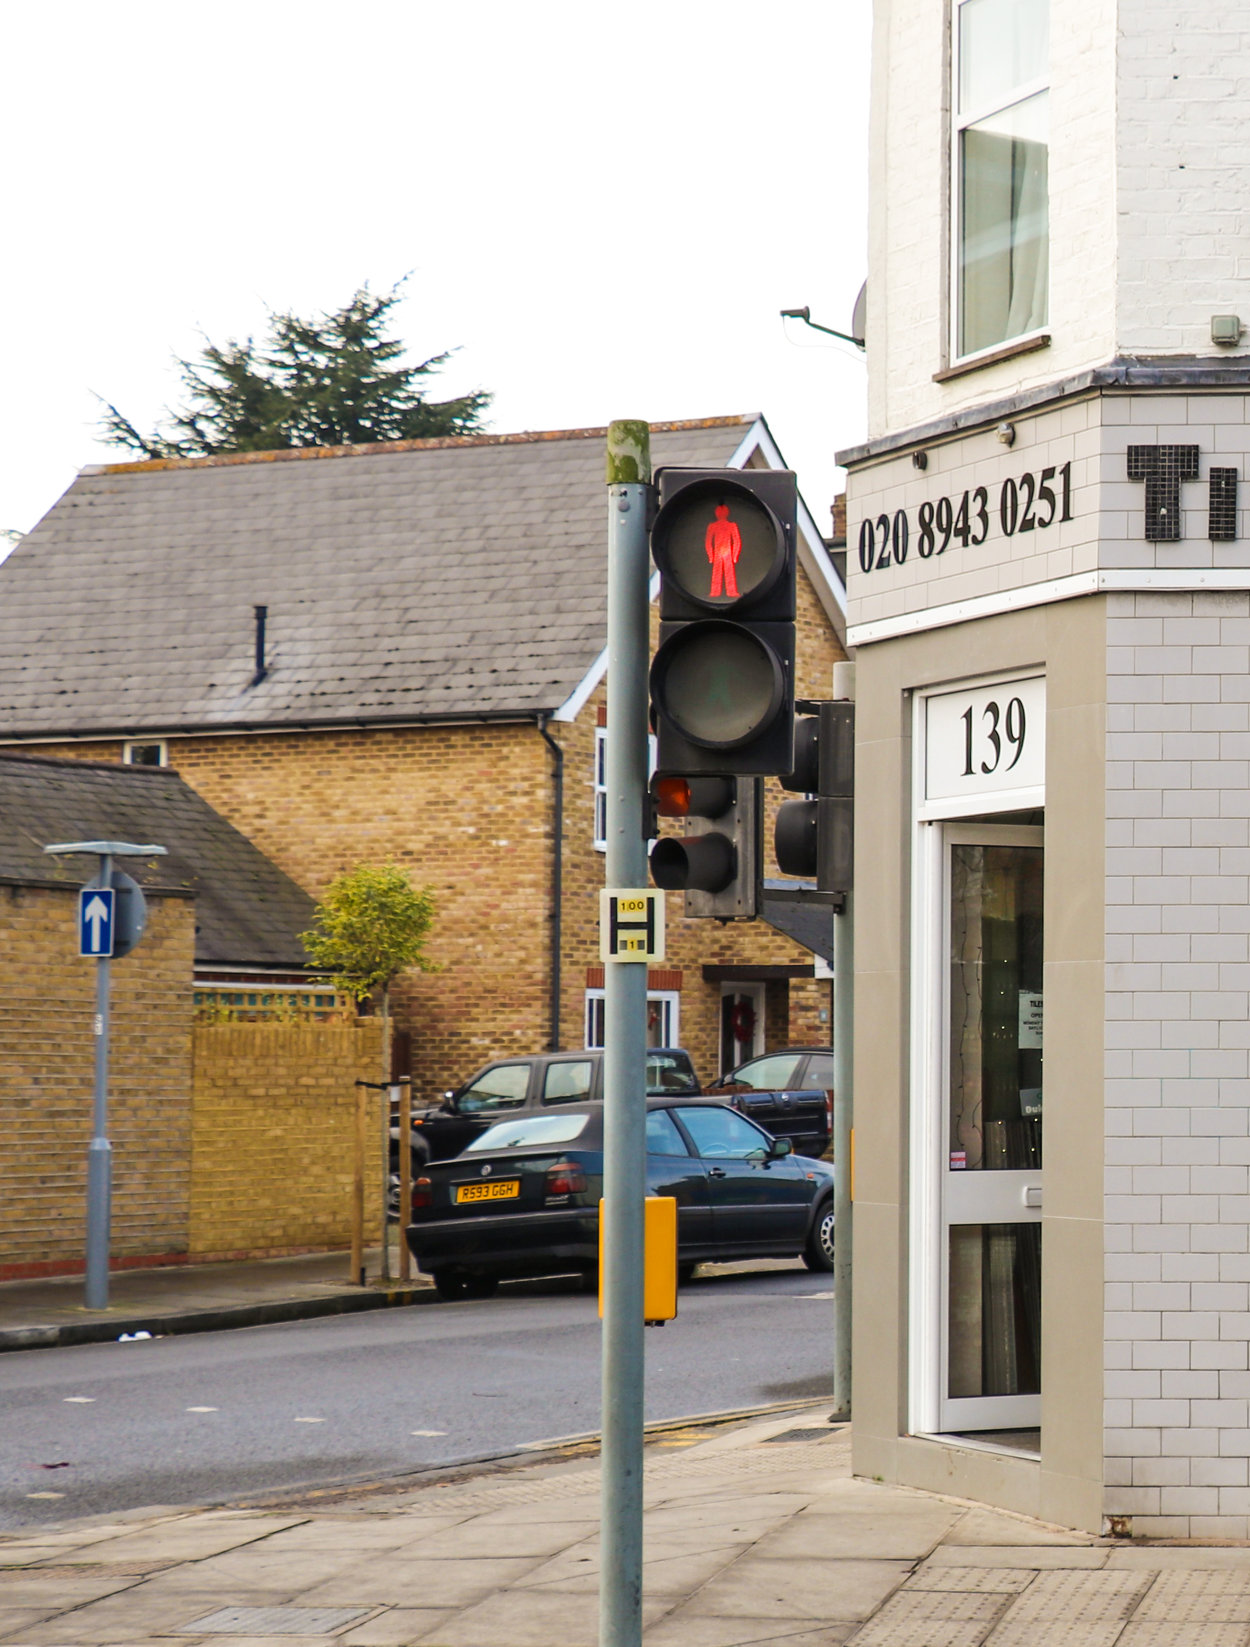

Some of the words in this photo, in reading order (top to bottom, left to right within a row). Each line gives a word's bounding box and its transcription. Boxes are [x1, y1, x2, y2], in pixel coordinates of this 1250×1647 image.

[859, 508, 909, 574] 020
[918, 486, 990, 559] 8943
[1000, 461, 1074, 537] 0251
[960, 697, 1027, 776] 139
[621, 901, 644, 911] 100
[610, 897, 654, 954] H
[630, 941, 634, 949] 1
[463, 1186, 489, 1200] R593
[492, 1184, 514, 1197] GGH
